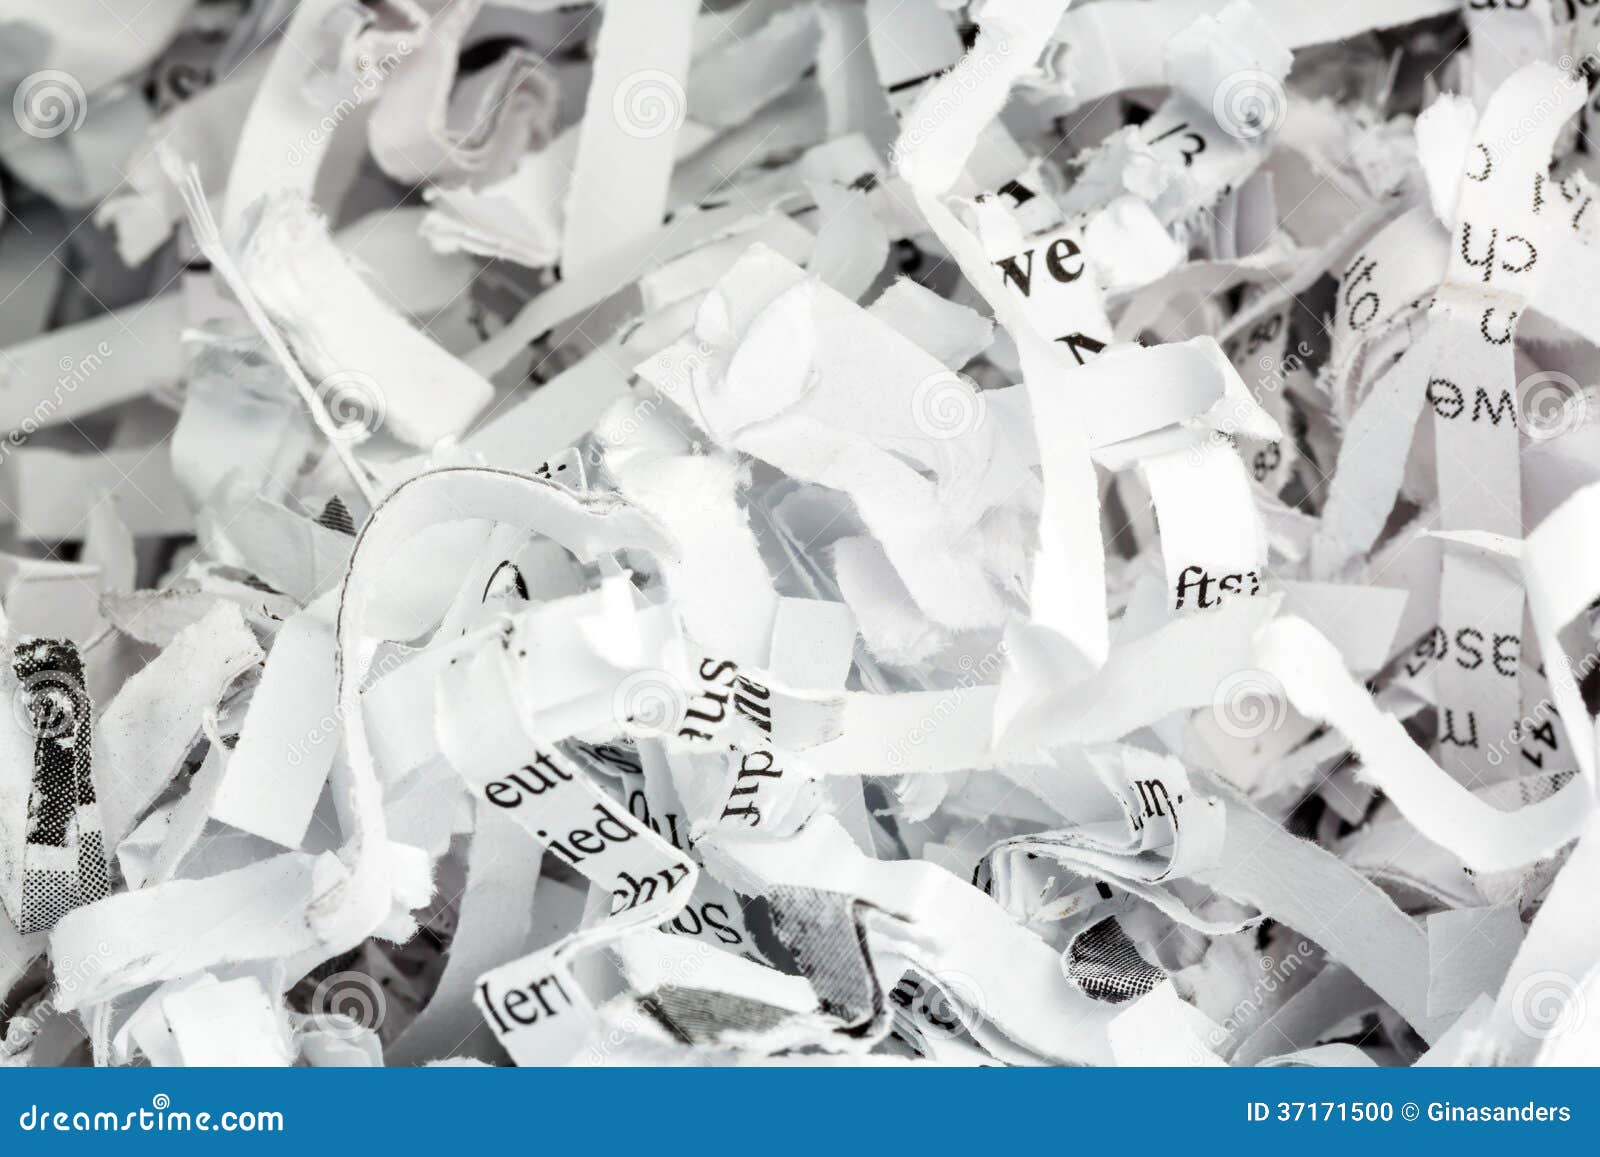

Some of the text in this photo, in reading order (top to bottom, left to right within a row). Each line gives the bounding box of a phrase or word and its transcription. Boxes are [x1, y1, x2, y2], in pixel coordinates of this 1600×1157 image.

[994, 238, 1085, 298] ve
[484, 750, 574, 809] eut
[536, 803, 639, 864] ied
